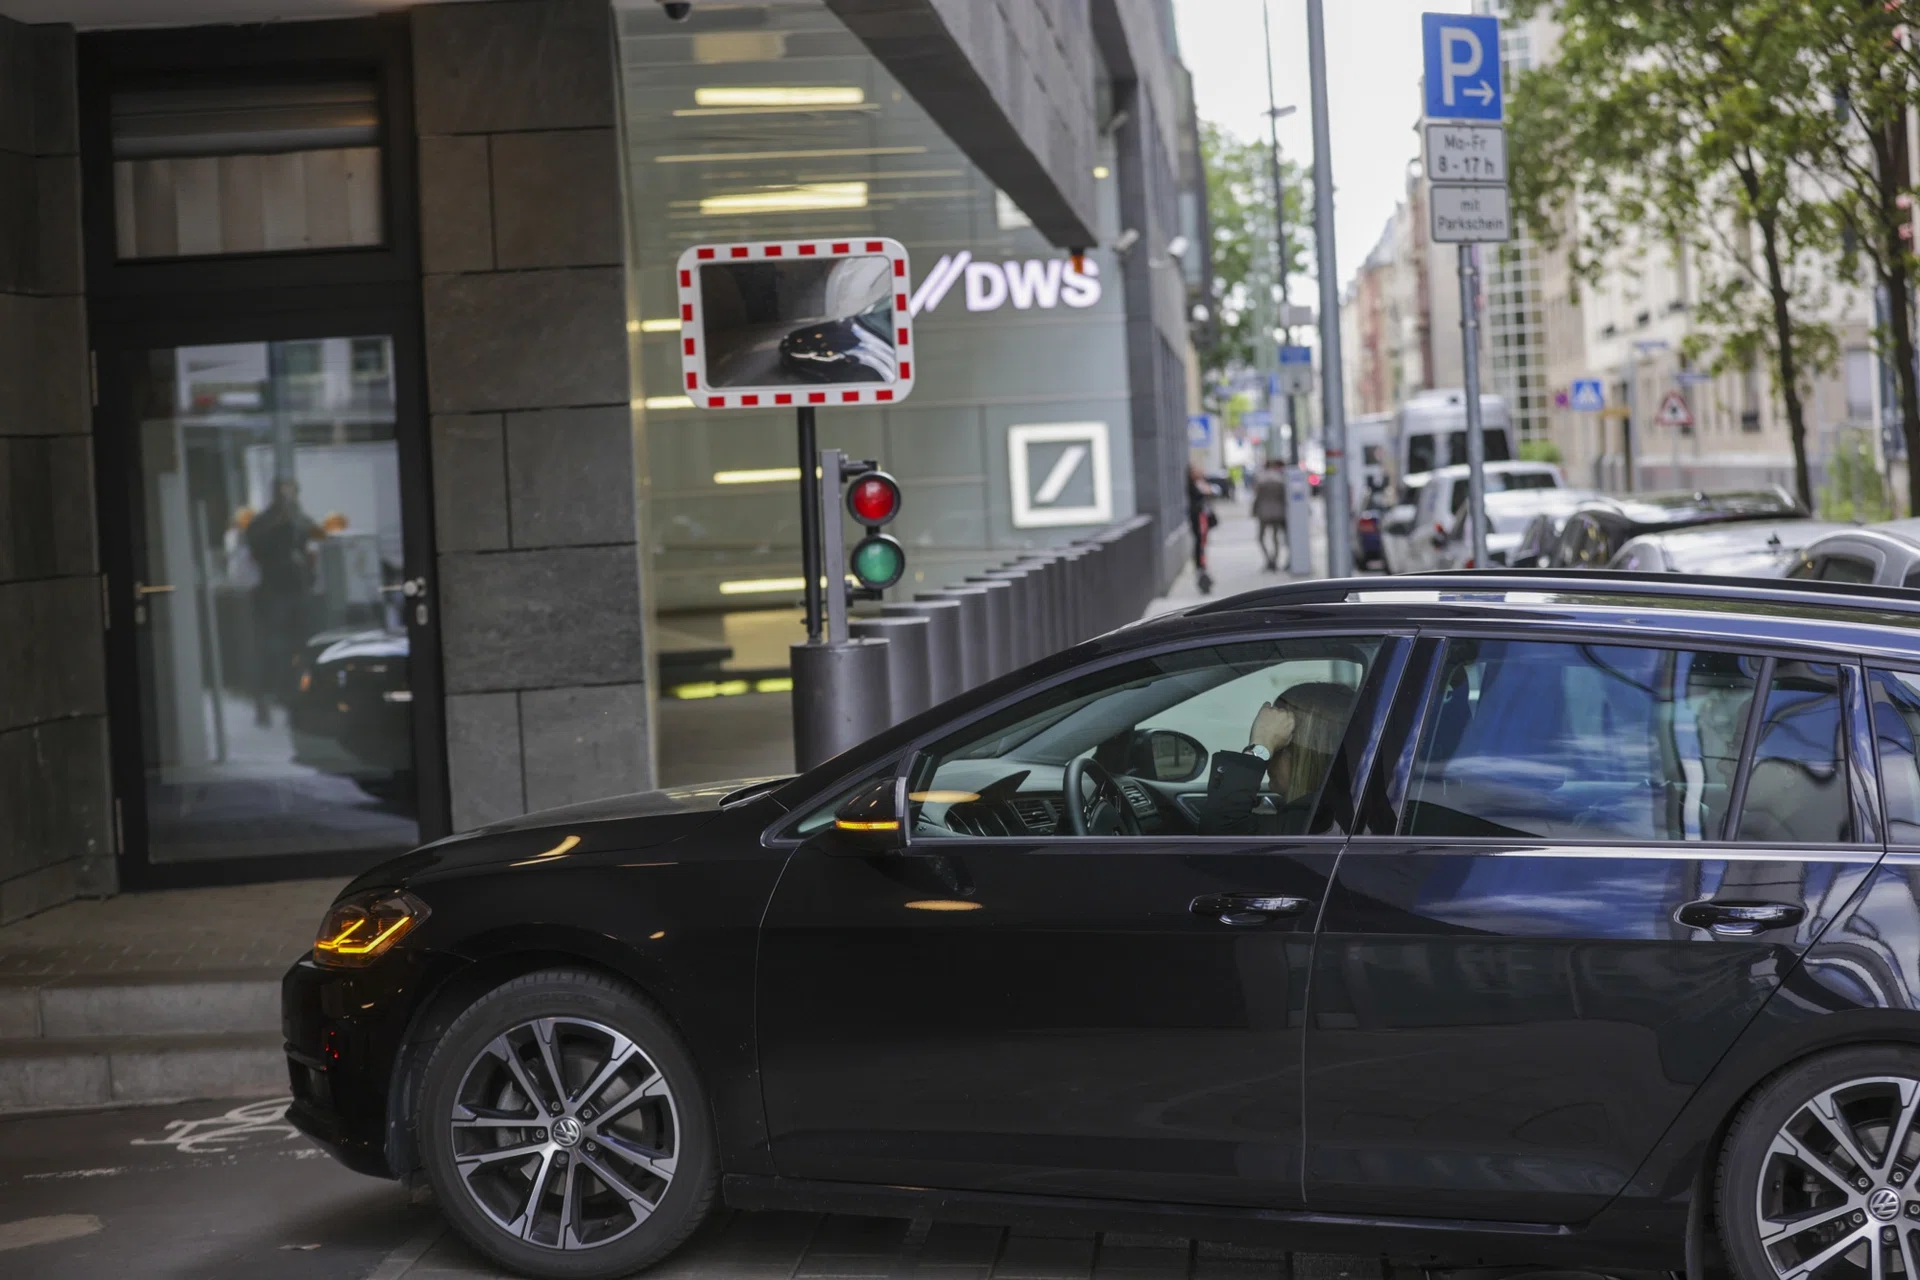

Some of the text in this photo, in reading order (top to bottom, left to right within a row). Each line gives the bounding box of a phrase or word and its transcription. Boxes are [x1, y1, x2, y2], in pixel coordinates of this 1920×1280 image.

[1441, 26, 1484, 106] P
[1444, 134, 1486, 151] Mo-Fr
[1438, 155, 1447, 173] 8
[1464, 156, 1479, 173] 17
[1484, 156, 1494, 174] h
[1438, 215, 1505, 231] Parkschein
